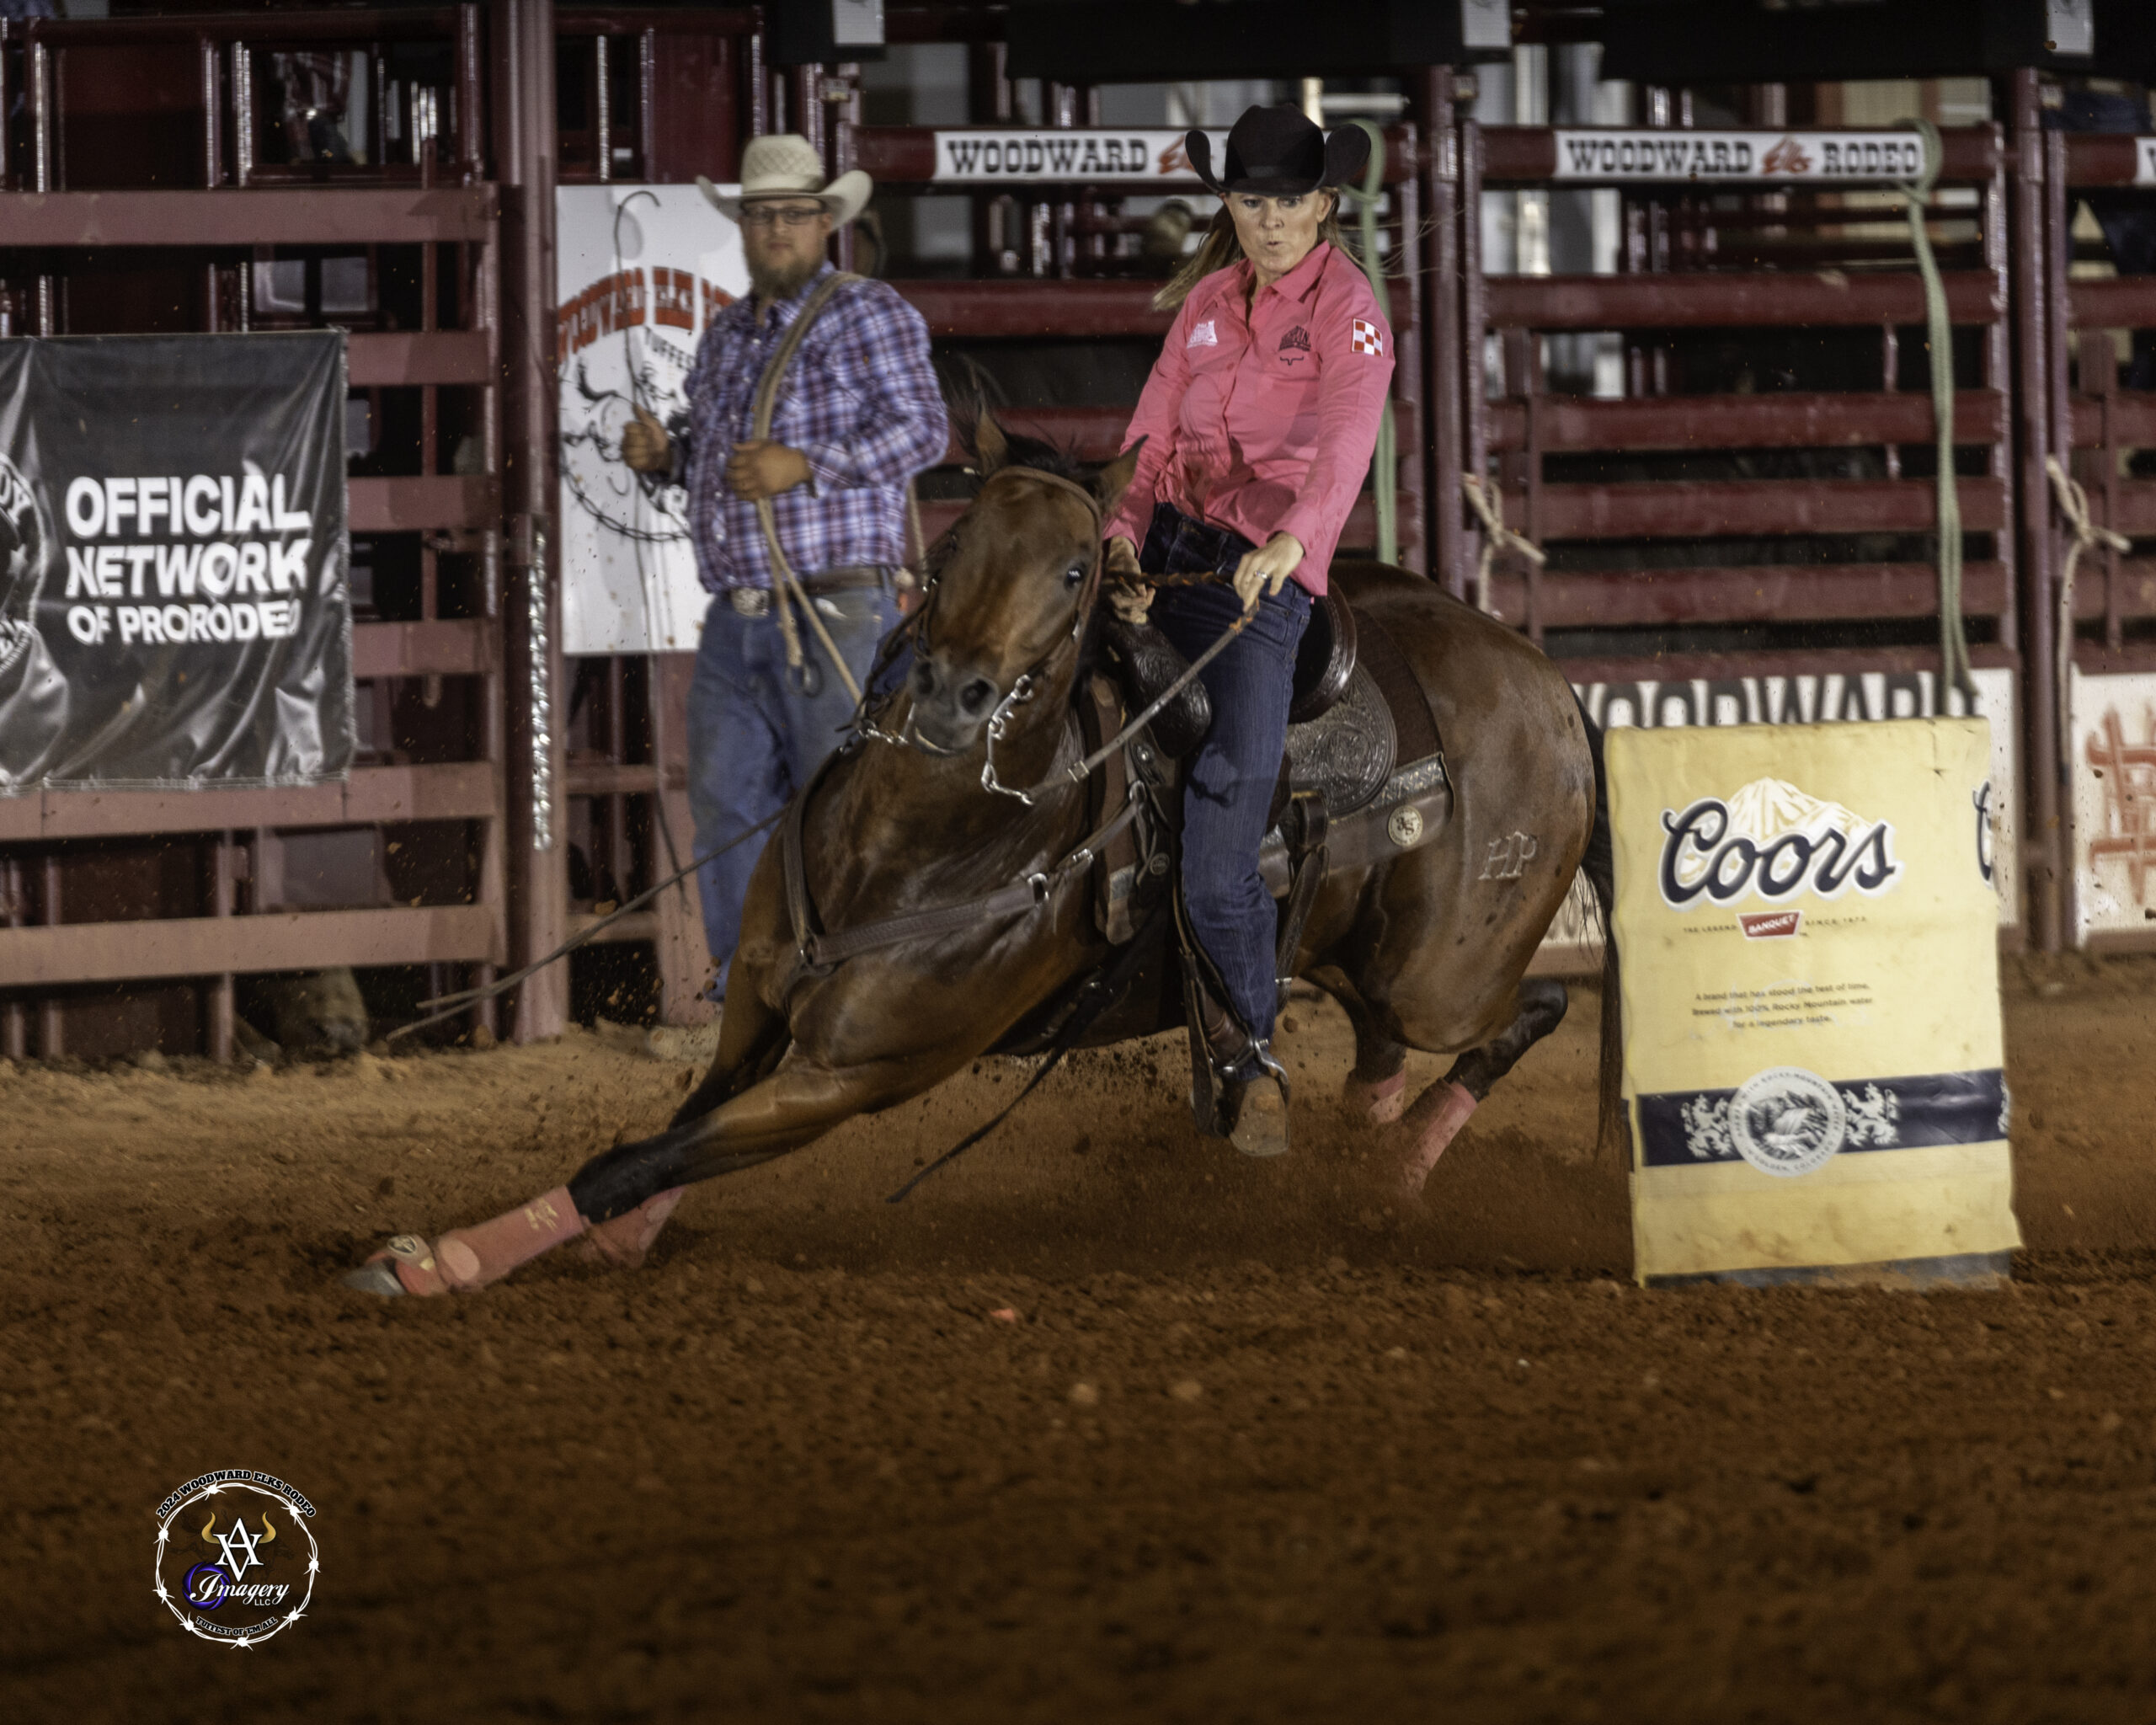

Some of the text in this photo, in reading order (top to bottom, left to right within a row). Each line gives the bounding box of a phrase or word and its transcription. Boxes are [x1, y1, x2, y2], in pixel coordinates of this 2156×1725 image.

[947, 138, 1148, 174] WOODWARD
[1566, 138, 1753, 174] WOODWARD
[1822, 142, 1917, 174] RODEO
[65, 473, 312, 539] OFFICIAL
[64, 539, 312, 599] NETWORK
[67, 605, 111, 645] OF
[1660, 798, 1900, 906] Coors
[1748, 913, 1795, 934] BANQUET
